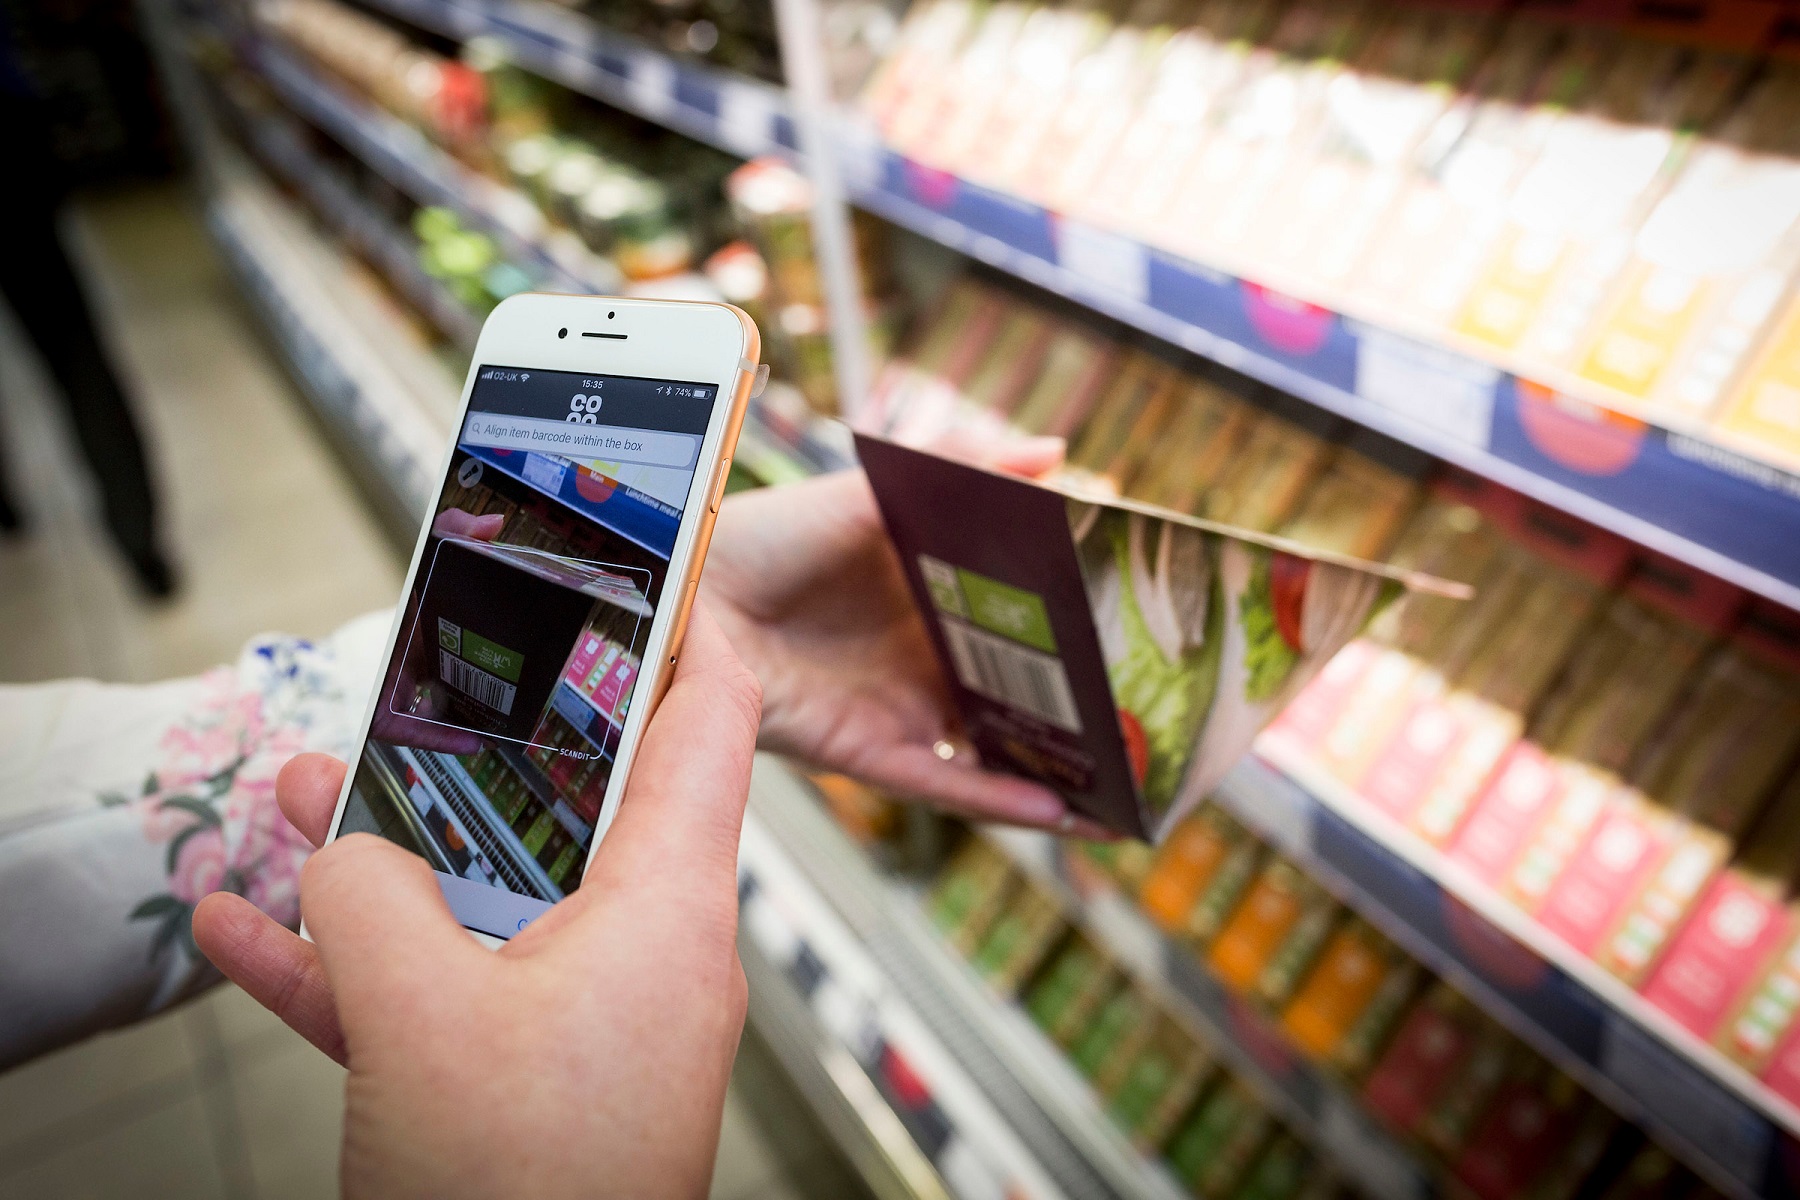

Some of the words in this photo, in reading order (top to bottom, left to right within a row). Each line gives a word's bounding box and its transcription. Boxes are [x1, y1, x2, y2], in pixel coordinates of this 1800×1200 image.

[493, 371, 518, 382] O2-UK
[582, 379, 604, 389] 15:35
[674, 387, 692, 397] 74%
[570, 393, 602, 413] CO
[484, 424, 507, 438] Align
[509, 425, 530, 439] item
[532, 430, 571, 444] barcode
[573, 434, 603, 447] within
[605, 437, 622, 449] the
[623, 439, 643, 451] box
[625, 487, 659, 509] Lunchtime
[659, 504, 679, 518] meal
[559, 748, 591, 760] SCANDIT
